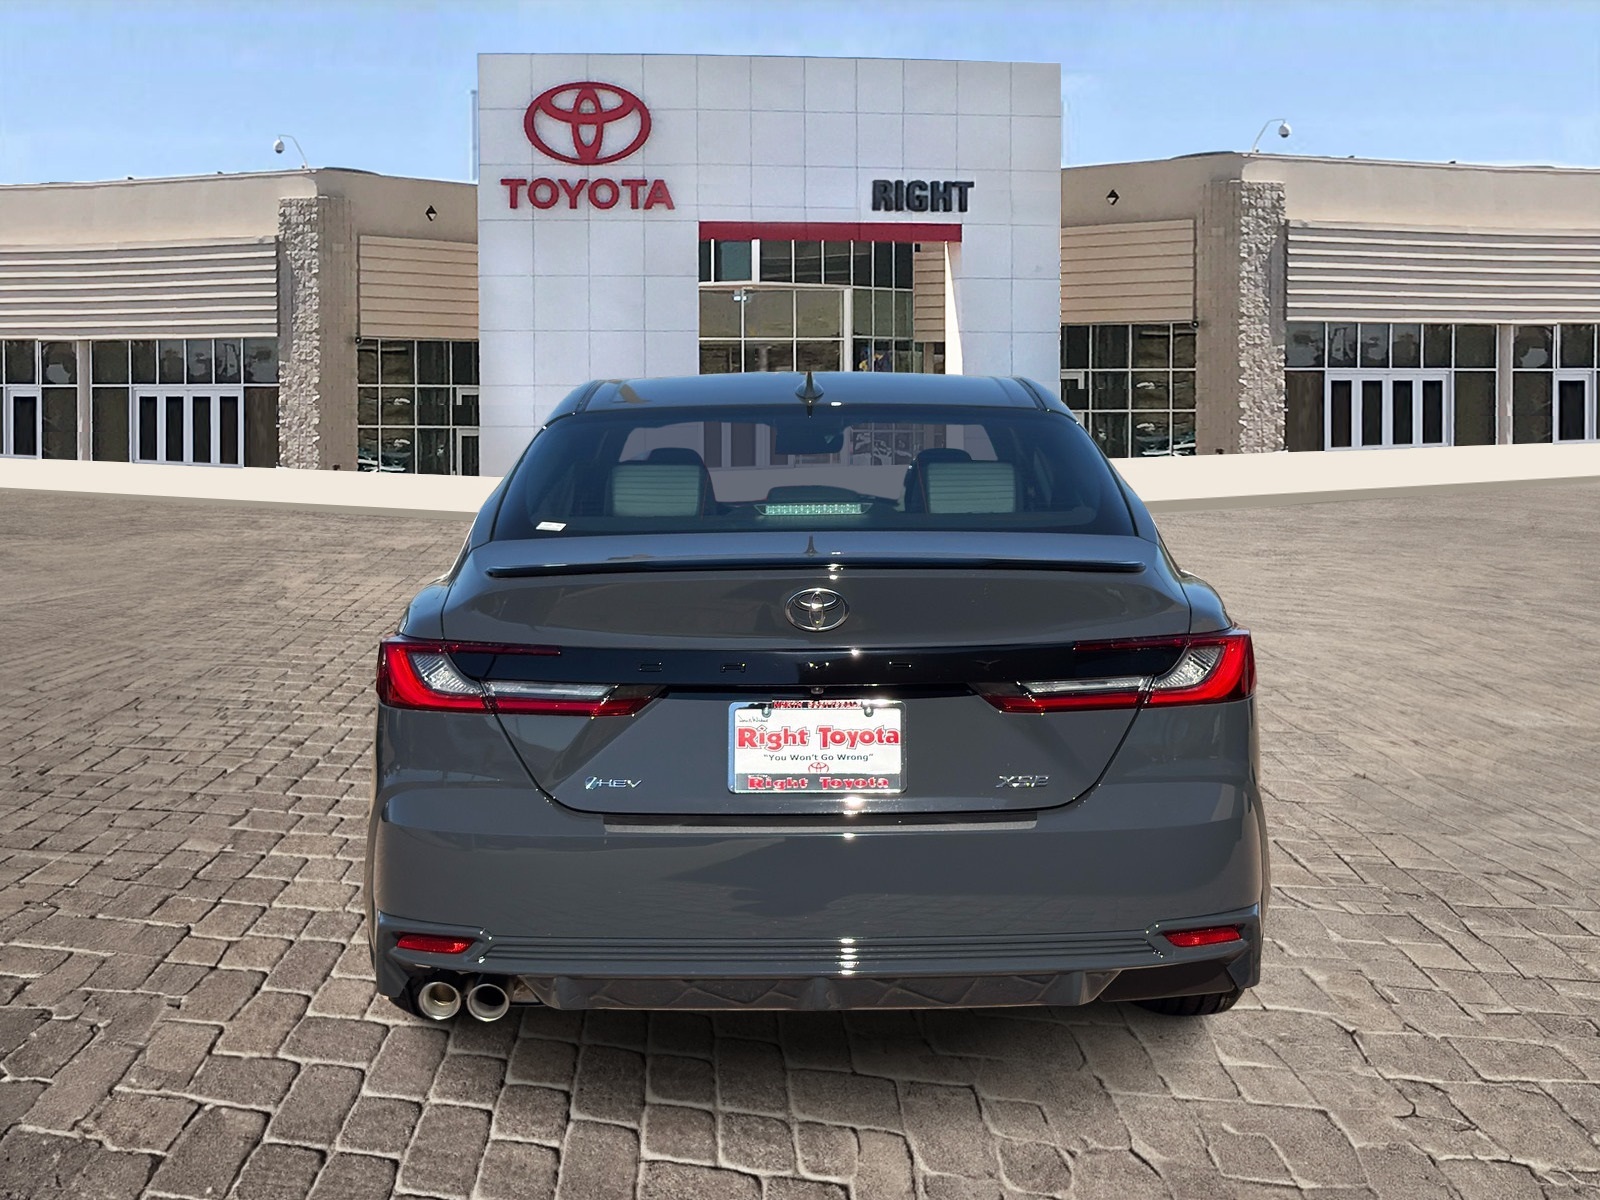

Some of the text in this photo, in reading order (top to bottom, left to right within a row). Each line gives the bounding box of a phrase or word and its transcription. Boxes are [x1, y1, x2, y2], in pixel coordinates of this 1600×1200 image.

[500, 178, 675, 210] TOYOTA
[871, 179, 975, 212] RIGHT
[737, 725, 900, 752] Right Toyota
[790, 753, 818, 761] Won't
[821, 753, 834, 761] Go
[748, 775, 889, 791] Right Toyota
